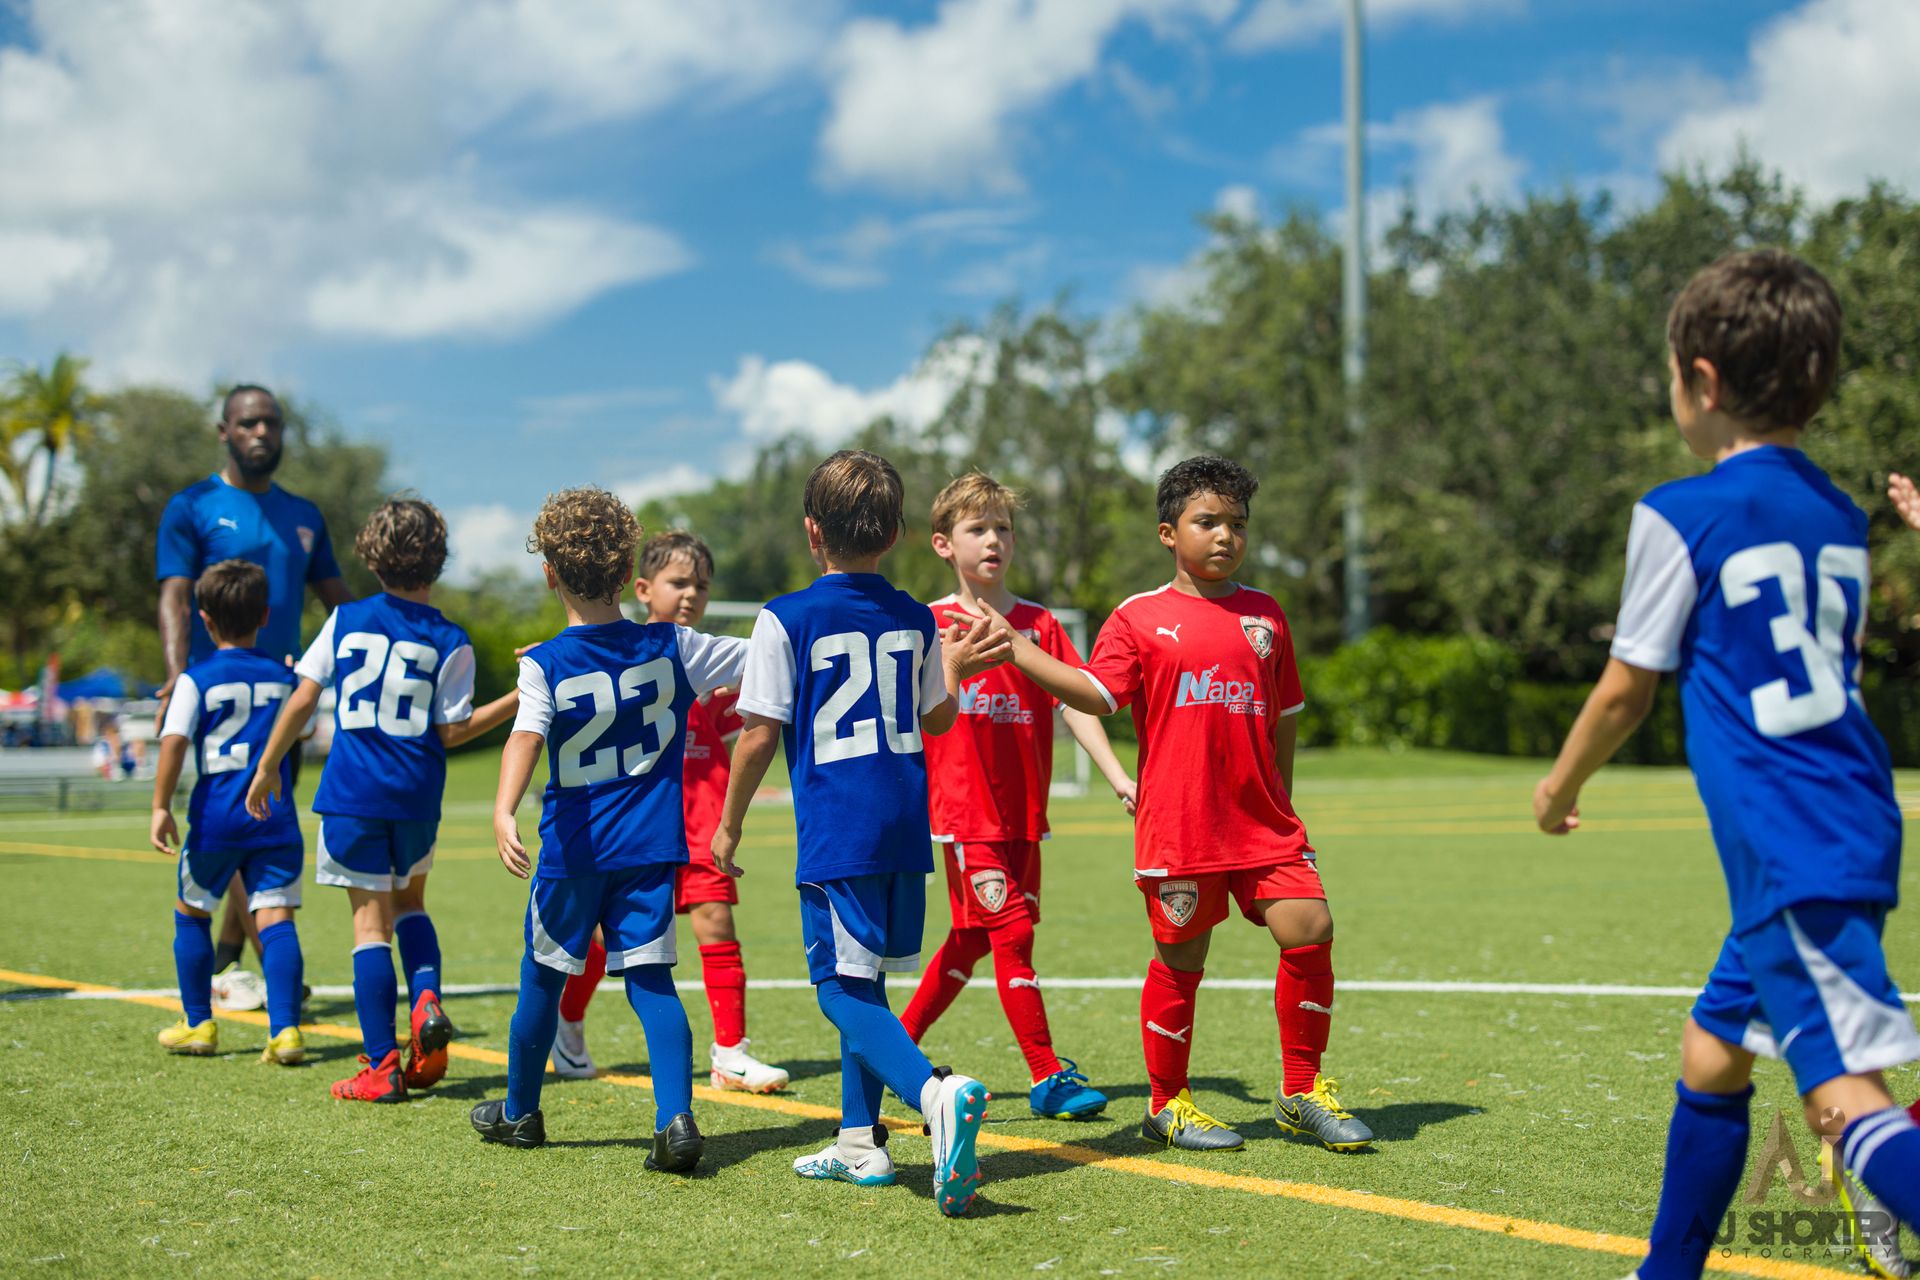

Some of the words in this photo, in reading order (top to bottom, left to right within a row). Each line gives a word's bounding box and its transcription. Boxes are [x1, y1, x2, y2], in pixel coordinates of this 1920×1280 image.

[337, 632, 439, 737] 26
[1175, 666, 1255, 707] Napa
[1720, 541, 1870, 737] 30
[204, 683, 292, 775] 27
[555, 657, 676, 788] 23
[811, 630, 925, 765] 20
[958, 682, 1020, 718] Napa
[1229, 703, 1266, 716] RESEARC
